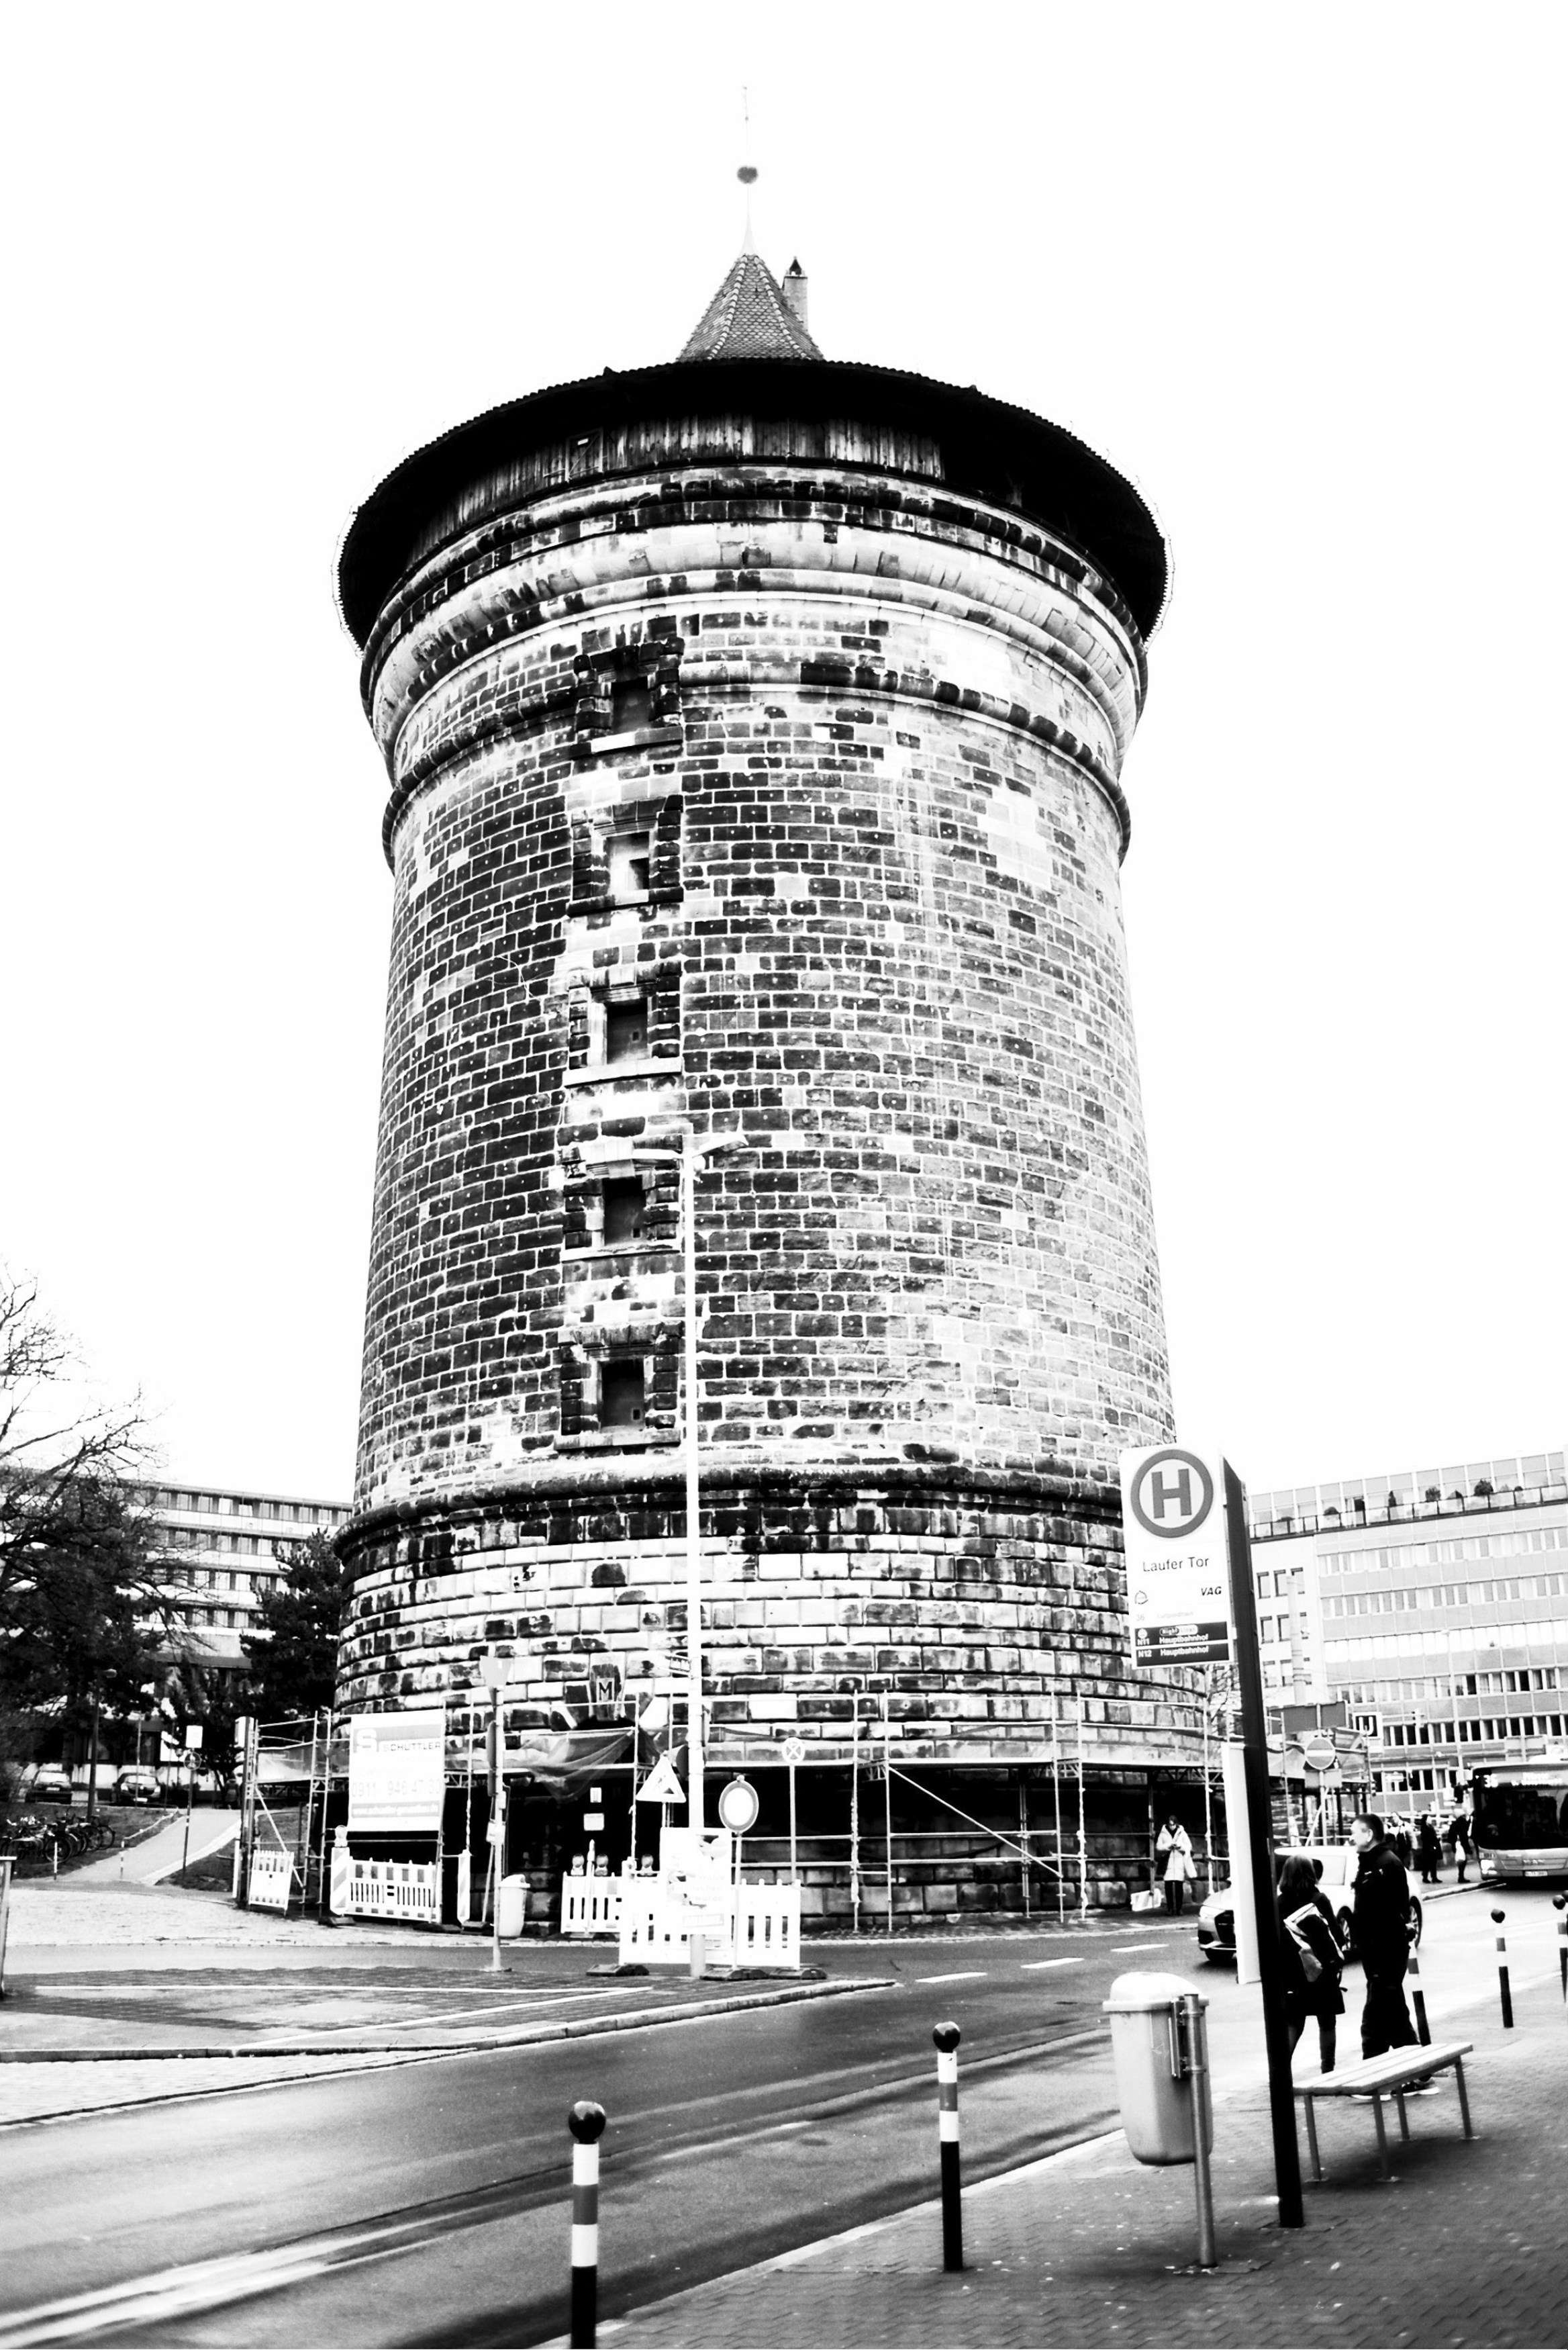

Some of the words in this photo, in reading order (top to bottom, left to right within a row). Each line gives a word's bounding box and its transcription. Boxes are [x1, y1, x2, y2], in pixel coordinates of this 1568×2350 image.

[1151, 1468, 1192, 1519] H
[1142, 1559, 1183, 1572] Laufer
[1187, 1556, 1210, 1568] Tor
[1200, 1586, 1222, 1597] VAG
[1137, 1638, 1150, 1646] N11
[1159, 1634, 1209, 1644] Hauptbahnhof
[1138, 1650, 1153, 1658] N12
[1160, 1646, 1209, 1657] Hauptbahnhof
[599, 1681, 613, 1701] M
[352, 1783, 376, 1798] 0911
